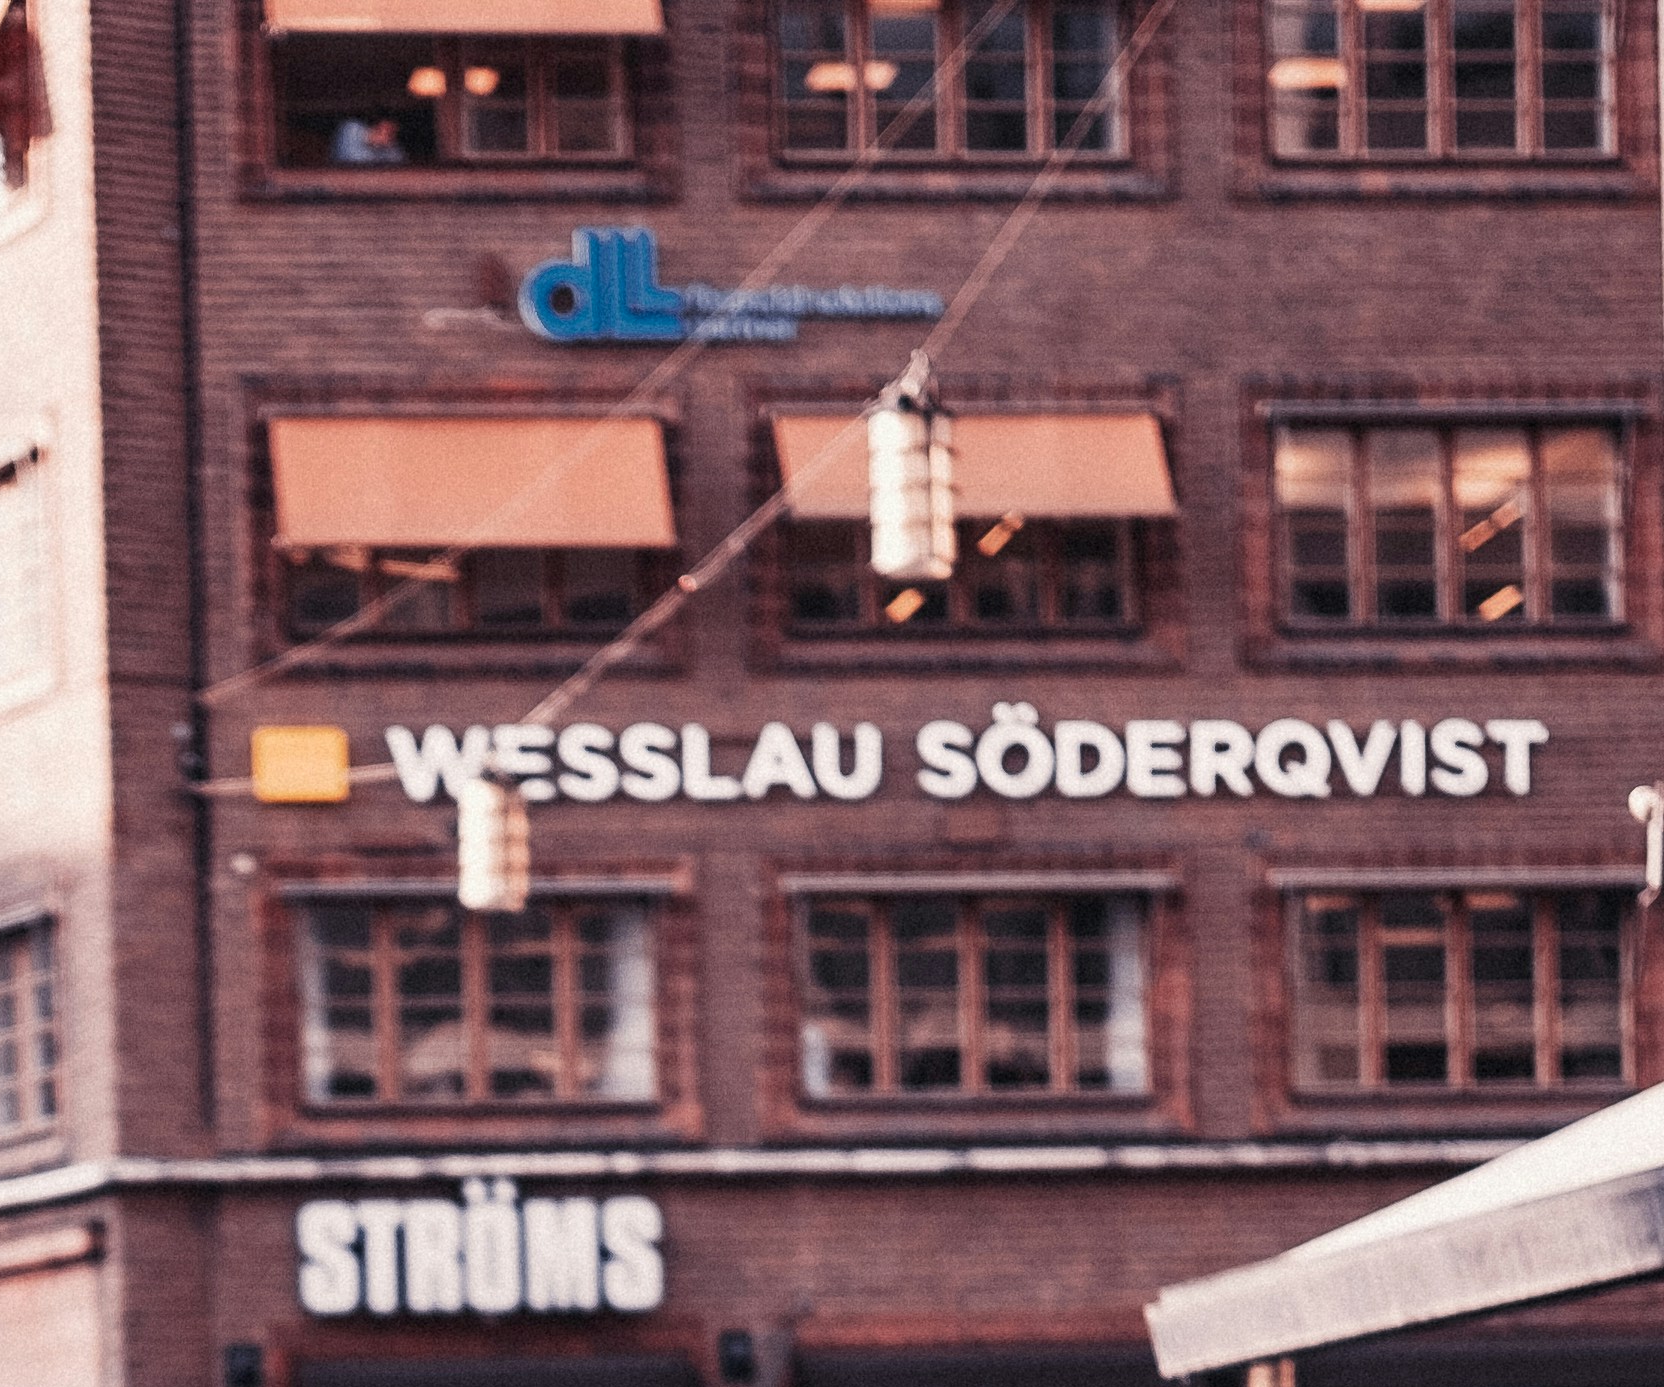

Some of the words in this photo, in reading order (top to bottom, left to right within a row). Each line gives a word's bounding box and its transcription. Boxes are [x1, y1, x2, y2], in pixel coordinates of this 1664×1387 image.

[384, 721, 883, 801] WESSLAU
[915, 701, 1549, 798] SÖDERQVIST
[296, 1176, 664, 1314] STRÖMS
